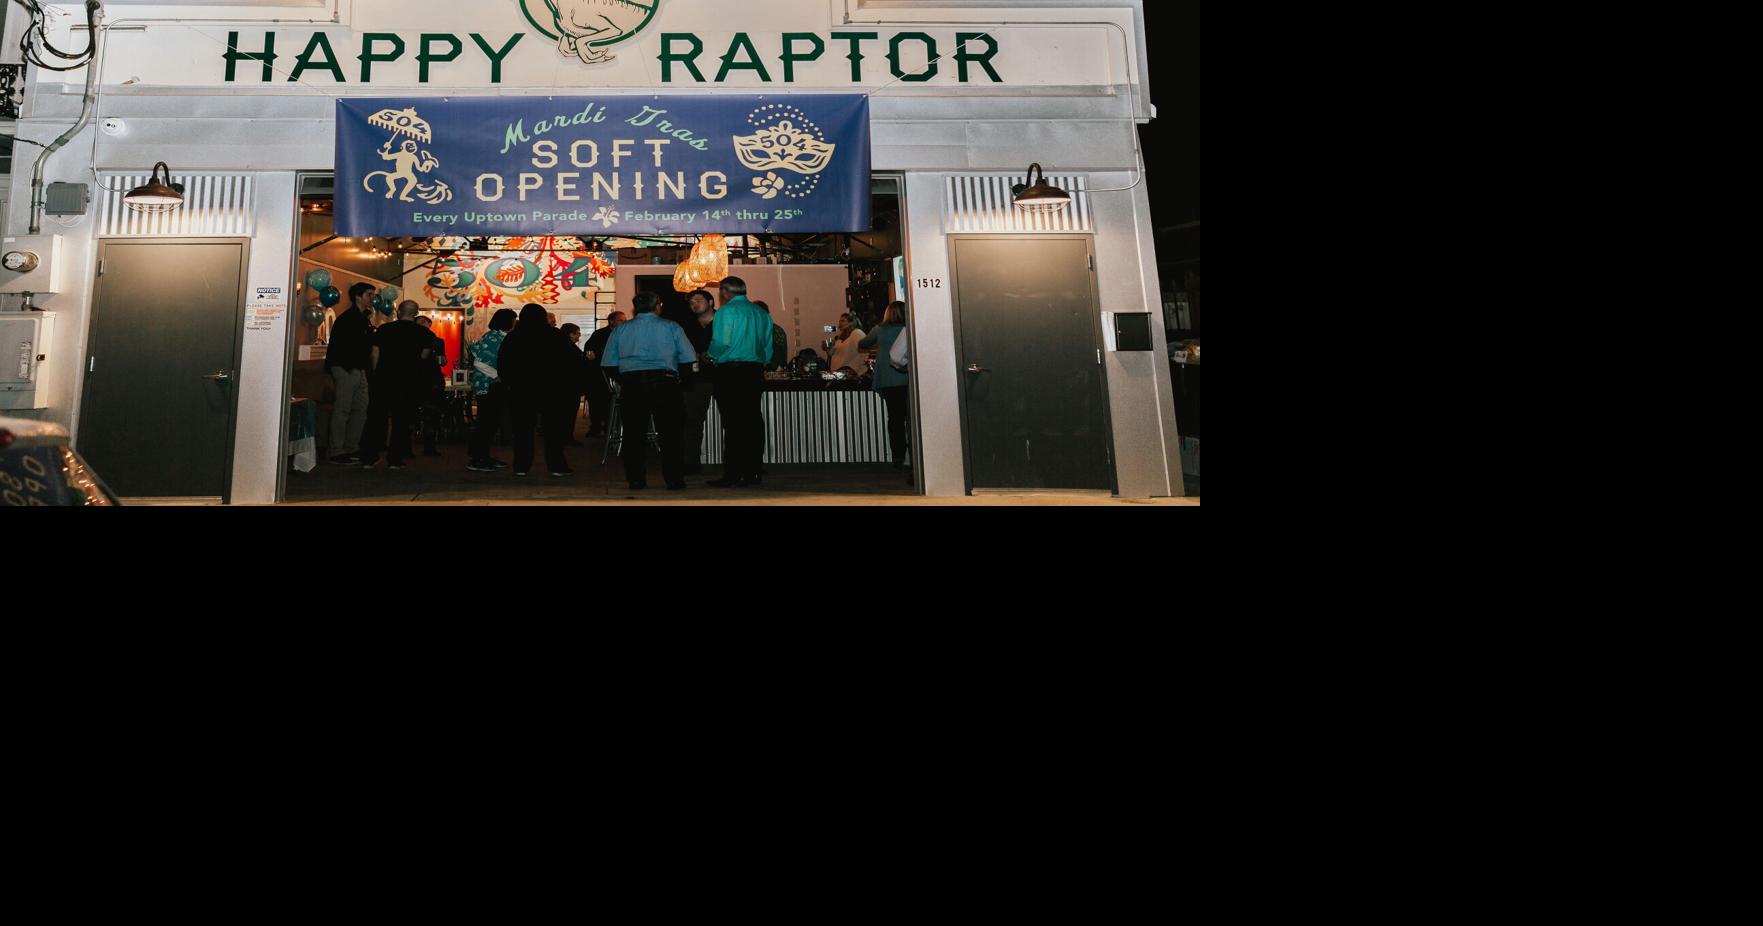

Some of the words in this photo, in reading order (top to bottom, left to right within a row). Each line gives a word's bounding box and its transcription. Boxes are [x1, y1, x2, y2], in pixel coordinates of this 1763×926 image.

[222, 31, 526, 84] HAPPY
[656, 31, 1004, 84] RAPTOR
[378, 110, 429, 135] 504
[500, 102, 607, 154] Mardi
[625, 105, 709, 151] Gras
[531, 139, 671, 169] SOFT
[760, 133, 808, 151] 504
[473, 170, 728, 202] OPENING
[413, 212, 459, 225] Every
[464, 211, 527, 224] Uptown
[532, 210, 588, 221] Parade
[624, 210, 697, 223] February
[702, 209, 732, 221] 14th
[736, 208, 769, 220] thru
[774, 208, 804, 220] 25th
[426, 257, 598, 291] 504
[917, 278, 941, 289] 1512
